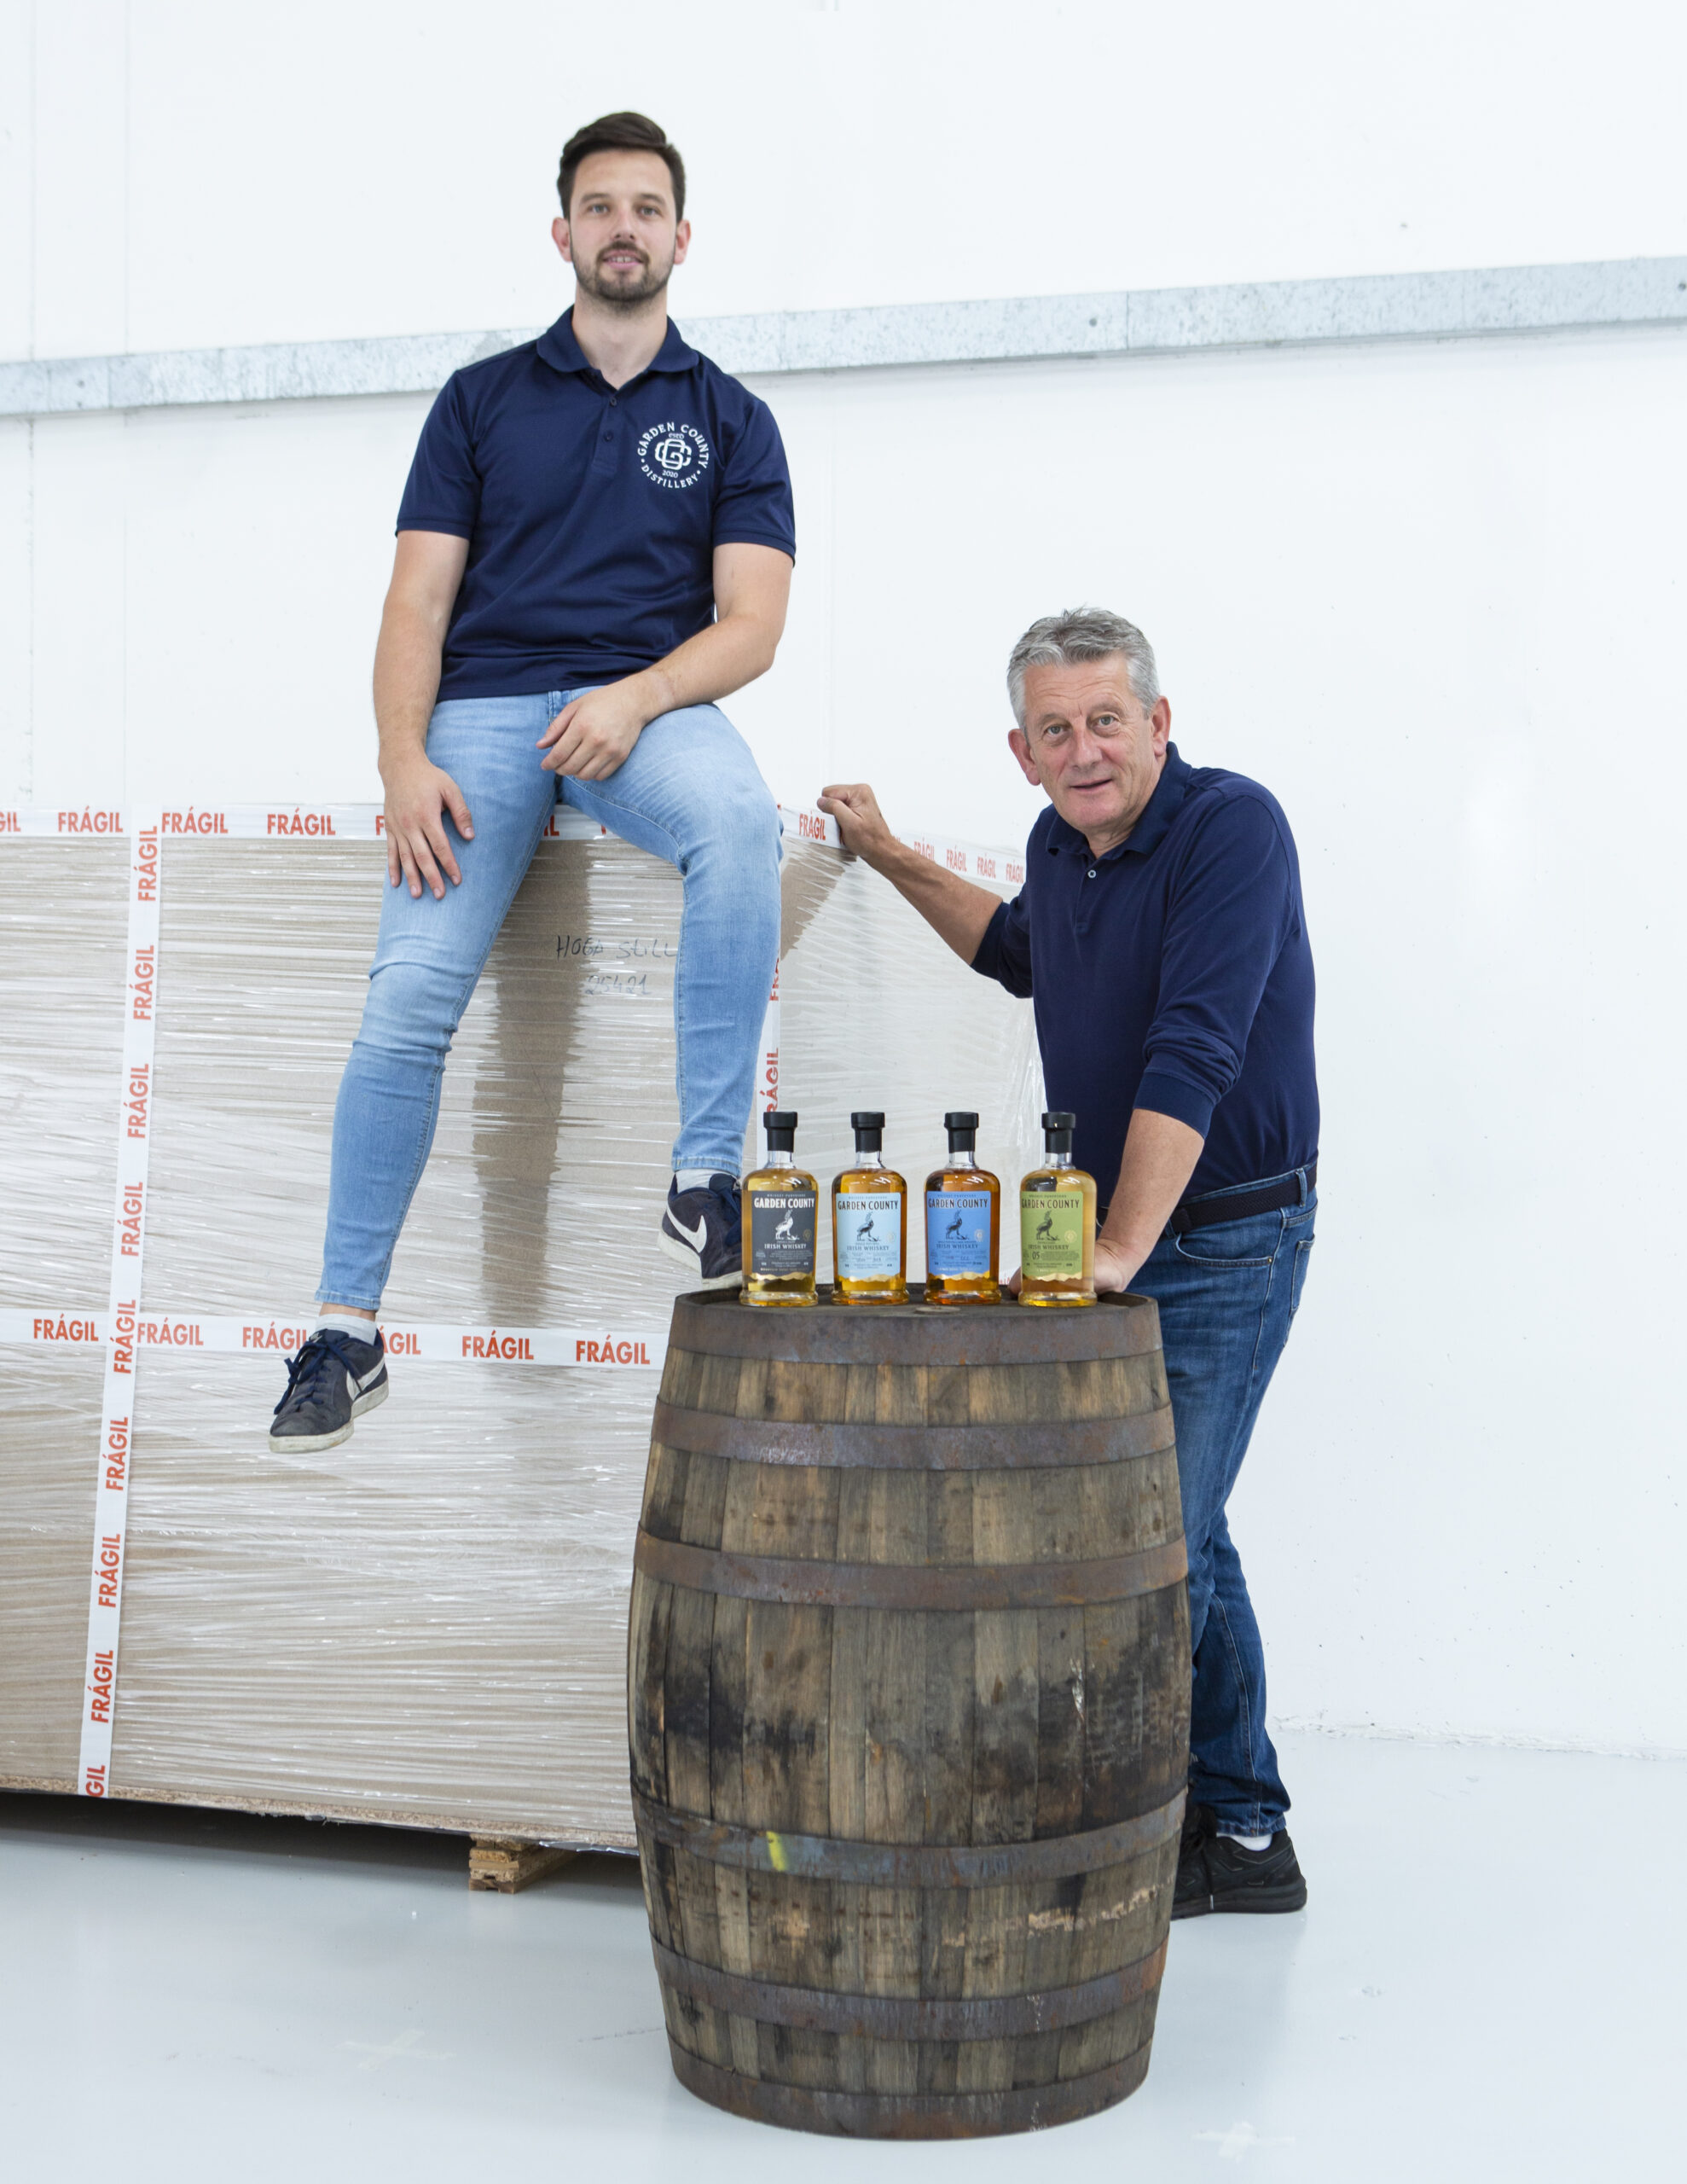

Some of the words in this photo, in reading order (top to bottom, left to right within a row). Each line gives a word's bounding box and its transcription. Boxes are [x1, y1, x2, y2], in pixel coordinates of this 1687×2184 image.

[637, 421, 675, 456] GARDEN
[681, 424, 710, 469] COUNTY
[641, 464, 699, 489] DISTILLERY
[662, 470, 679, 479] 2020
[58, 805, 124, 833] FRÁGIL
[162, 806, 229, 834] FRÁGIL
[267, 807, 336, 836] FRÁGIL
[134, 825, 158, 902] FRÁGIL
[798, 810, 826, 841] FRÁGIL
[946, 845, 967, 872] FRÁGIL
[977, 853, 997, 880] FRÁGIL
[1006, 859, 1024, 884] FRÁGIL
[128, 944, 154, 1021] FRÁGIL
[123, 1063, 149, 1139] FRÁGIL
[116, 1182, 143, 1258] FRÁGIL
[754, 1197, 786, 1209] GARDEN
[787, 1197, 815, 1209] COUNTY
[838, 1200, 867, 1210] GARDEN
[868, 1200, 898, 1210] COUNTY
[928, 1198, 954, 1208] GARDEN
[957, 1198, 988, 1208] COUNTY
[1022, 1199, 1045, 1209] GARDEN
[1047, 1199, 1080, 1209] COUNTY
[33, 1313, 99, 1342] FRÁGIL
[137, 1317, 204, 1346] FRÁGIL
[380, 1326, 421, 1356] GIL
[462, 1329, 535, 1360] FRÁGIL
[576, 1334, 651, 1365] FRÁGIL
[110, 1299, 136, 1374] FRÁGIL
[101, 1416, 129, 1491] FRÁGIL
[94, 1533, 121, 1608] FRÁGIL
[87, 1649, 113, 1723] FRÁGIL
[85, 1764, 106, 1798] GIL
